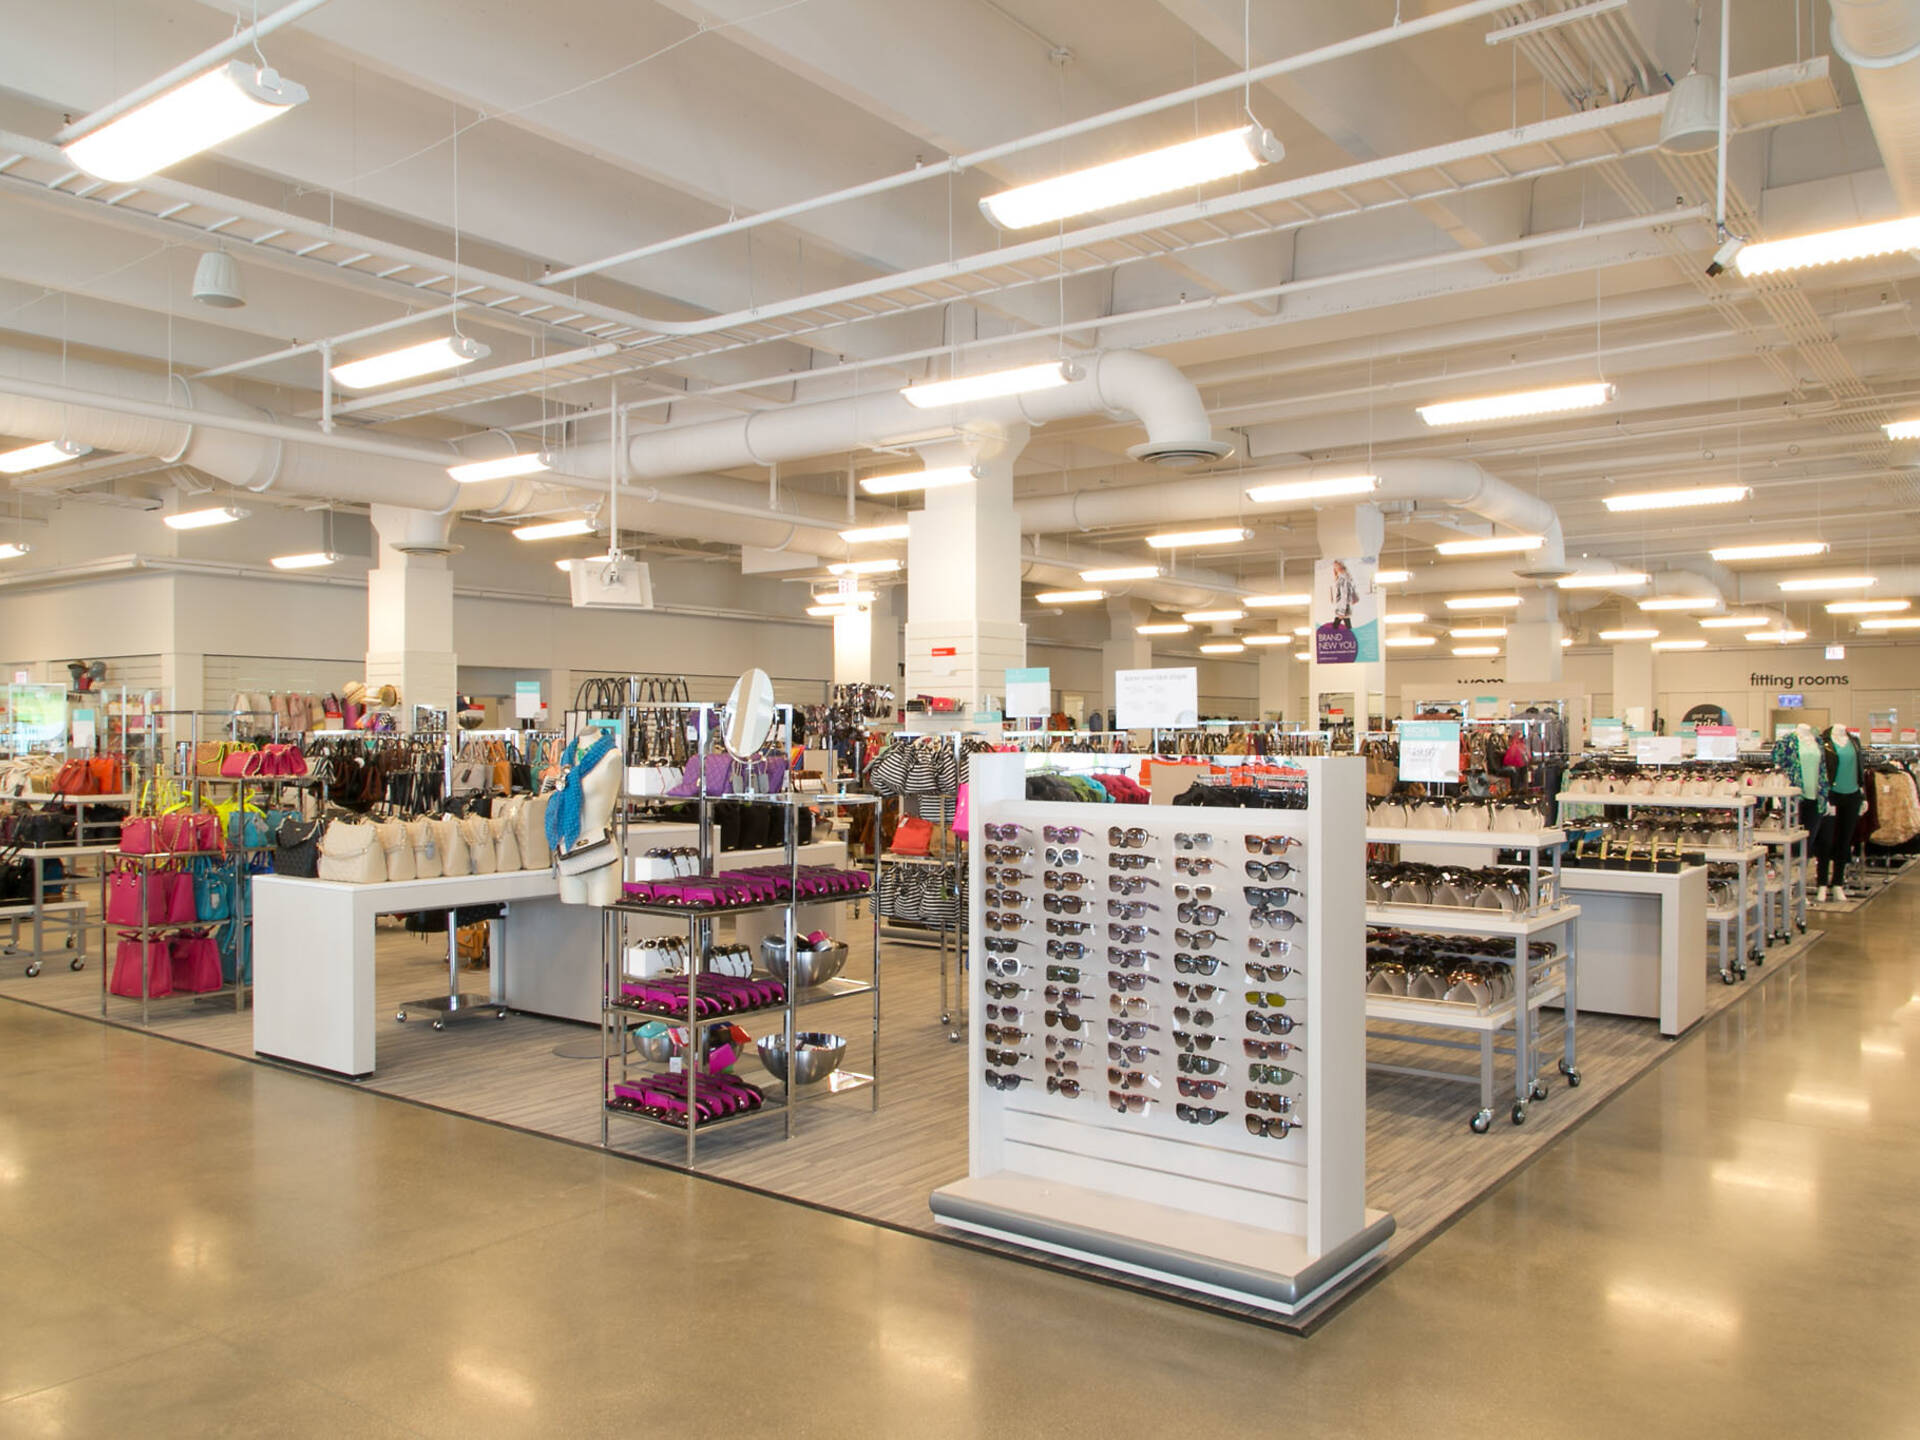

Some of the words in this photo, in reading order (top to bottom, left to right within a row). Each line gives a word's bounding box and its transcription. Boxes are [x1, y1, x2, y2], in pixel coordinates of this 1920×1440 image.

[1318, 633, 1343, 642] BRAND
[1318, 642, 1338, 650] NEW
[1339, 641, 1356, 649] YOU
[1750, 672, 1794, 689] fitting
[1798, 675, 1849, 686] rooms
